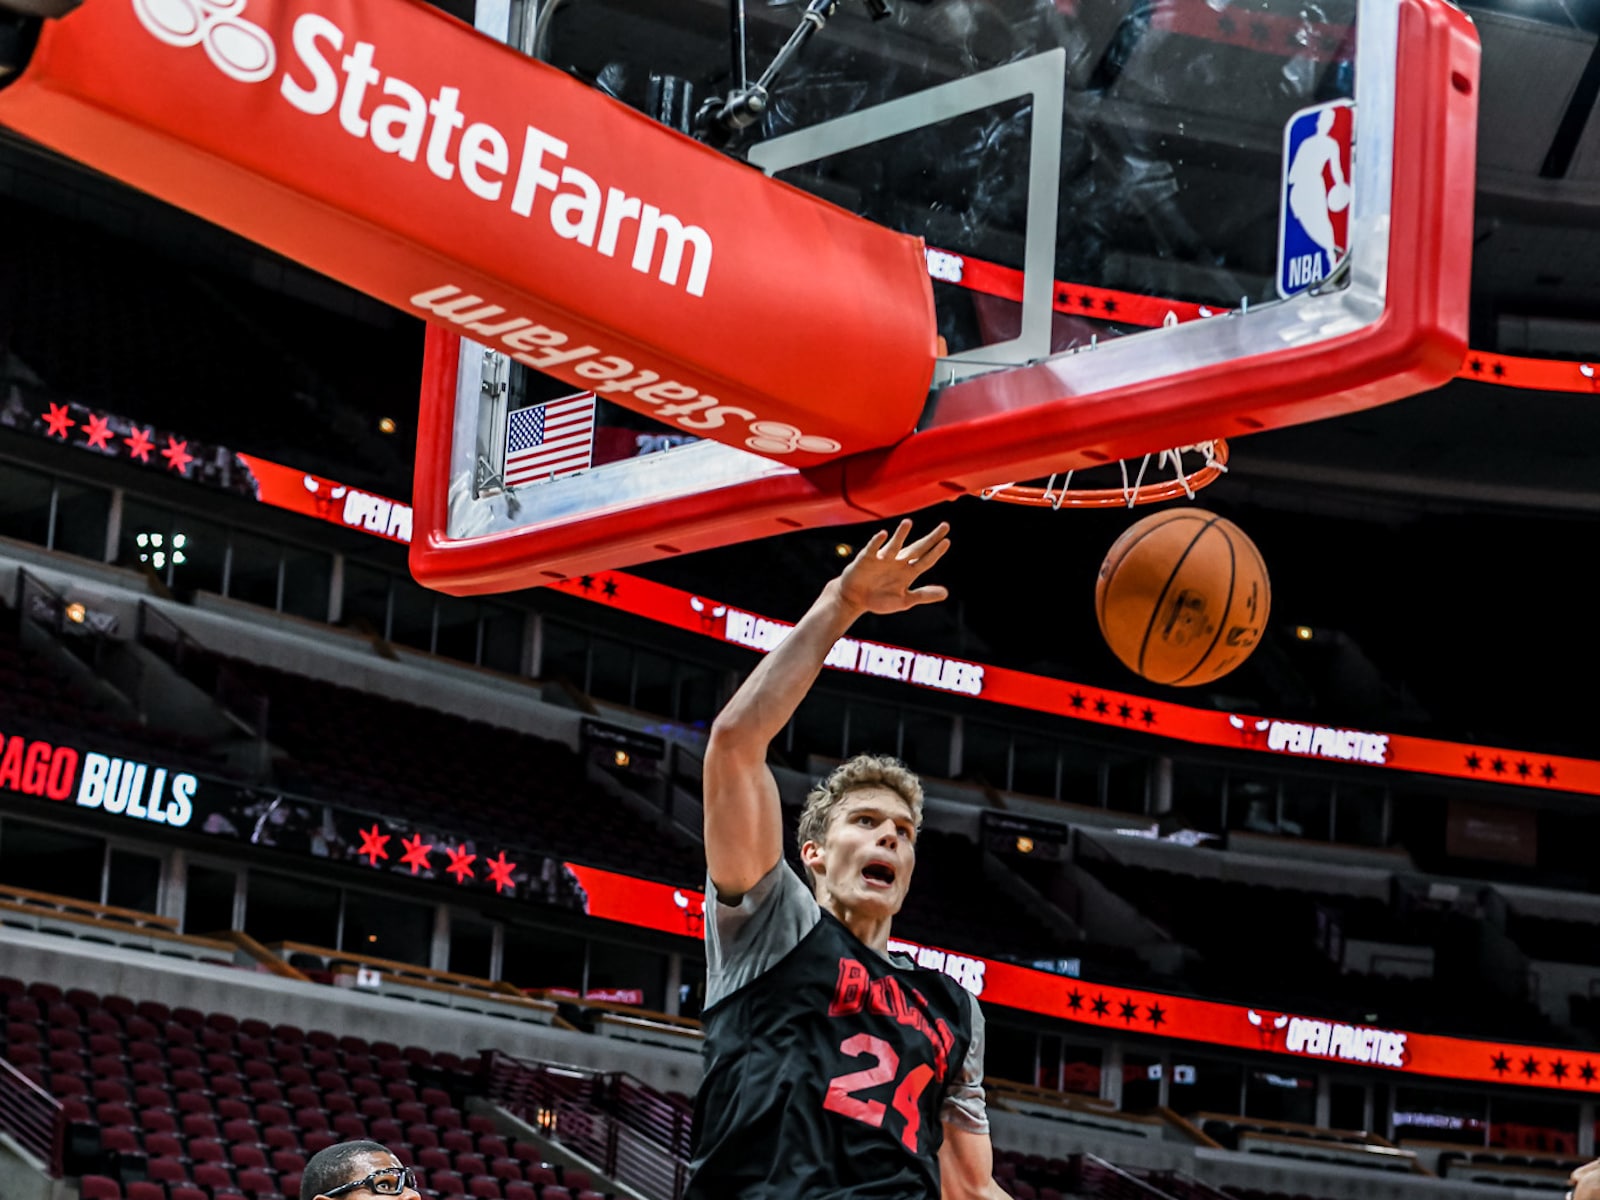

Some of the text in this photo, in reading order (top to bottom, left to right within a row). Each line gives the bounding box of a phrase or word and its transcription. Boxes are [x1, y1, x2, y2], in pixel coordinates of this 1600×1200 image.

[1288, 250, 1323, 289] NBA
[858, 641, 916, 682] TICKET
[911, 653, 984, 696] HOLDERS
[1267, 721, 1390, 764] OPEN PRACTICE
[0, 730, 198, 828] AGO BULLS
[1286, 1017, 1408, 1067] OPEN PRACTICE
[822, 1032, 935, 1154] 24
